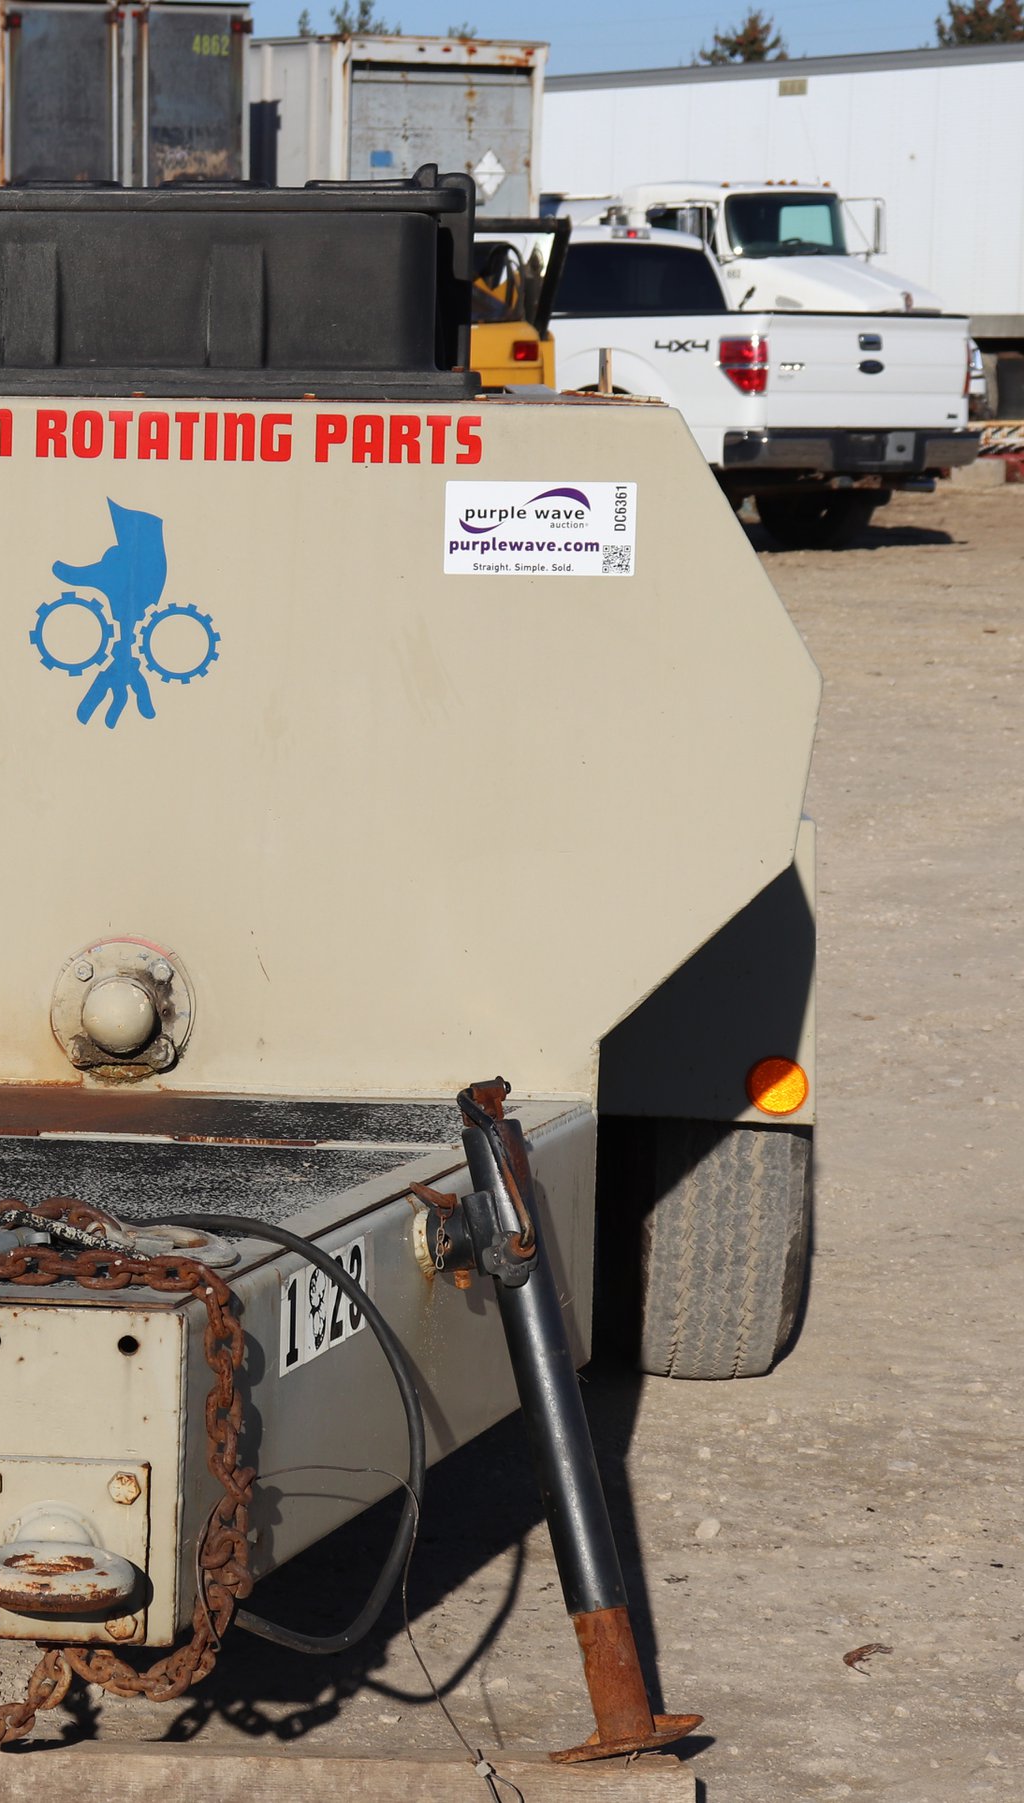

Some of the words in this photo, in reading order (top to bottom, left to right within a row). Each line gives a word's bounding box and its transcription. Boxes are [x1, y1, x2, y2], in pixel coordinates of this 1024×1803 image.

[192, 33, 230, 56] 4862
[35, 409, 293, 462] ROTATING
[315, 413, 483, 465] PARTS
[464, 506, 527, 523] purple
[535, 509, 586, 521] wave
[614, 485, 628, 532] DC6361
[449, 537, 601, 556] purplewave.com
[472, 562, 512, 573] Straight.
[514, 563, 549, 574] Simple.
[551, 563, 575, 573] Sold.
